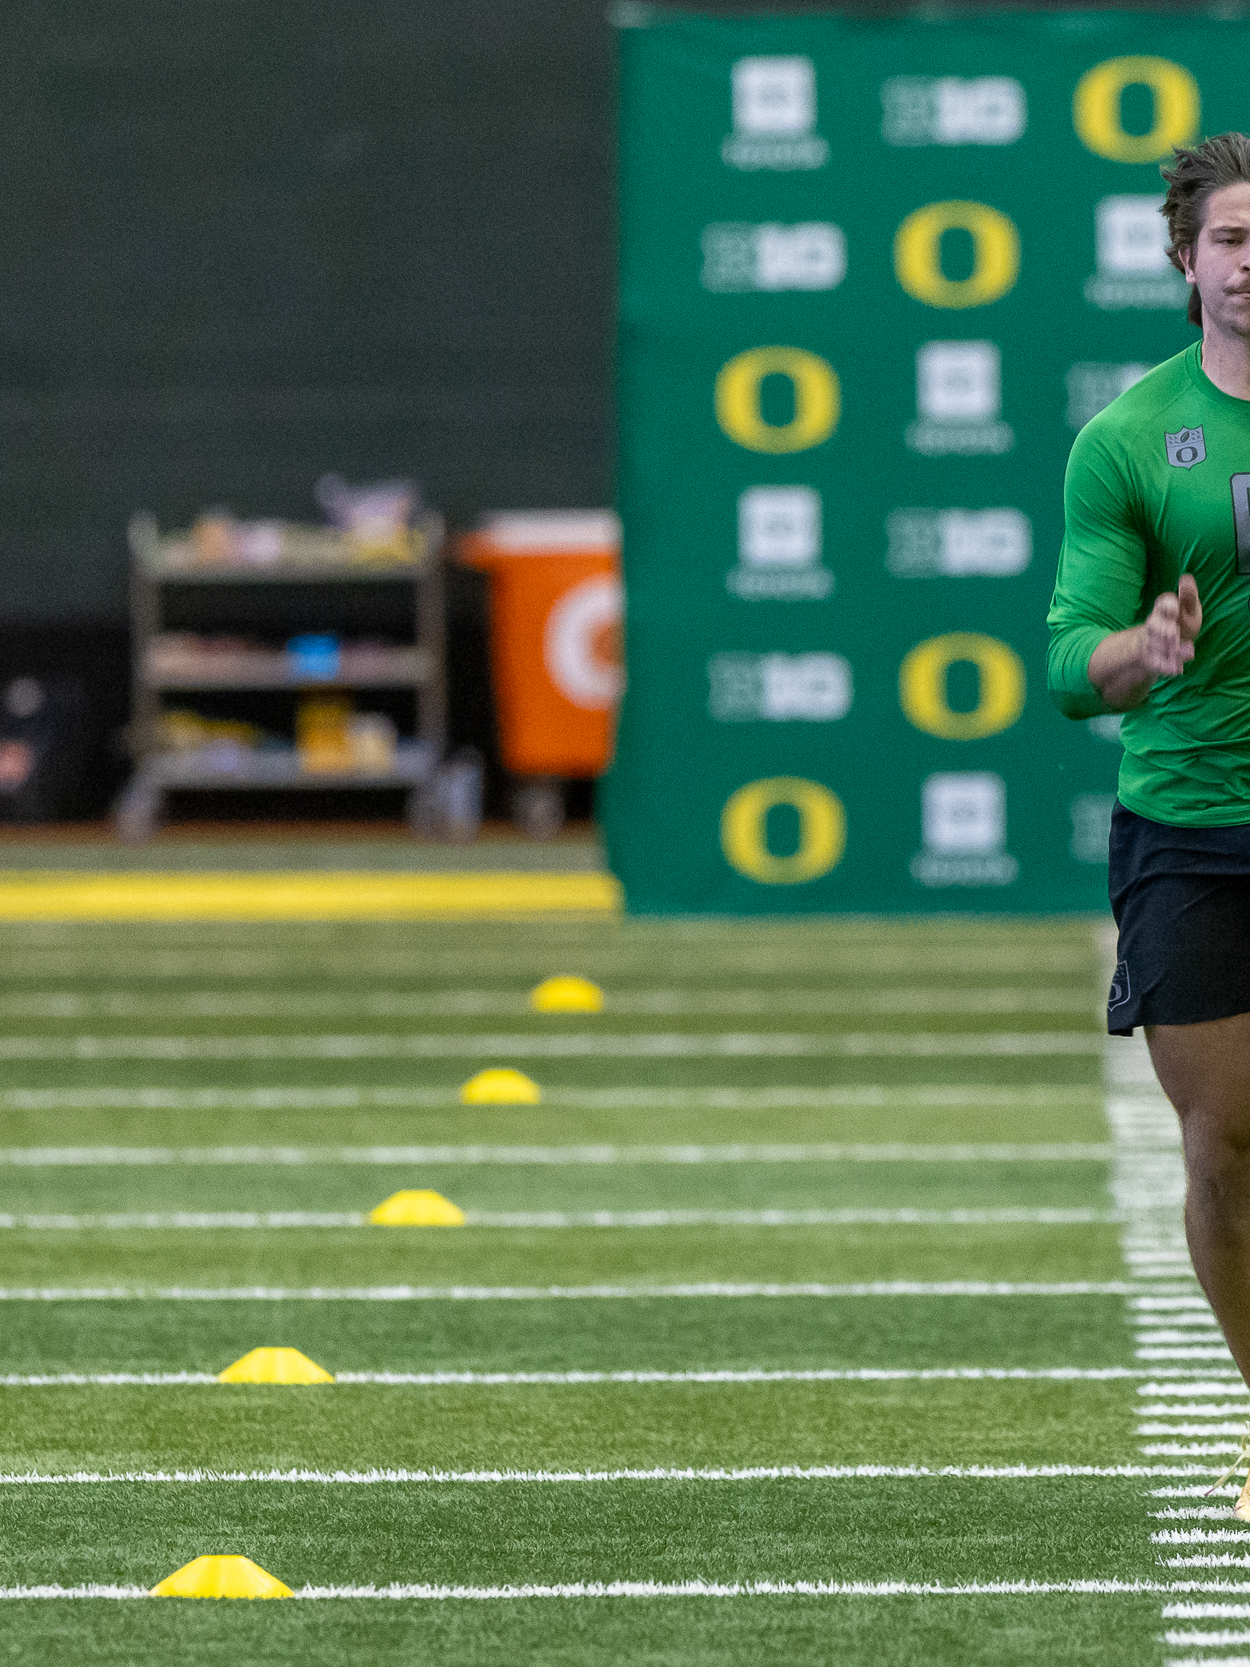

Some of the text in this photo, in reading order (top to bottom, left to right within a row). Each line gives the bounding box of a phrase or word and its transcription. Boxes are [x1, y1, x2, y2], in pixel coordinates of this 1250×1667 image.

[1074, 56, 1200, 162] O
[895, 202, 1019, 307] O
[715, 347, 840, 453] O
[1176, 446, 1198, 463] O
[900, 633, 1025, 739] O
[721, 777, 845, 883] O
